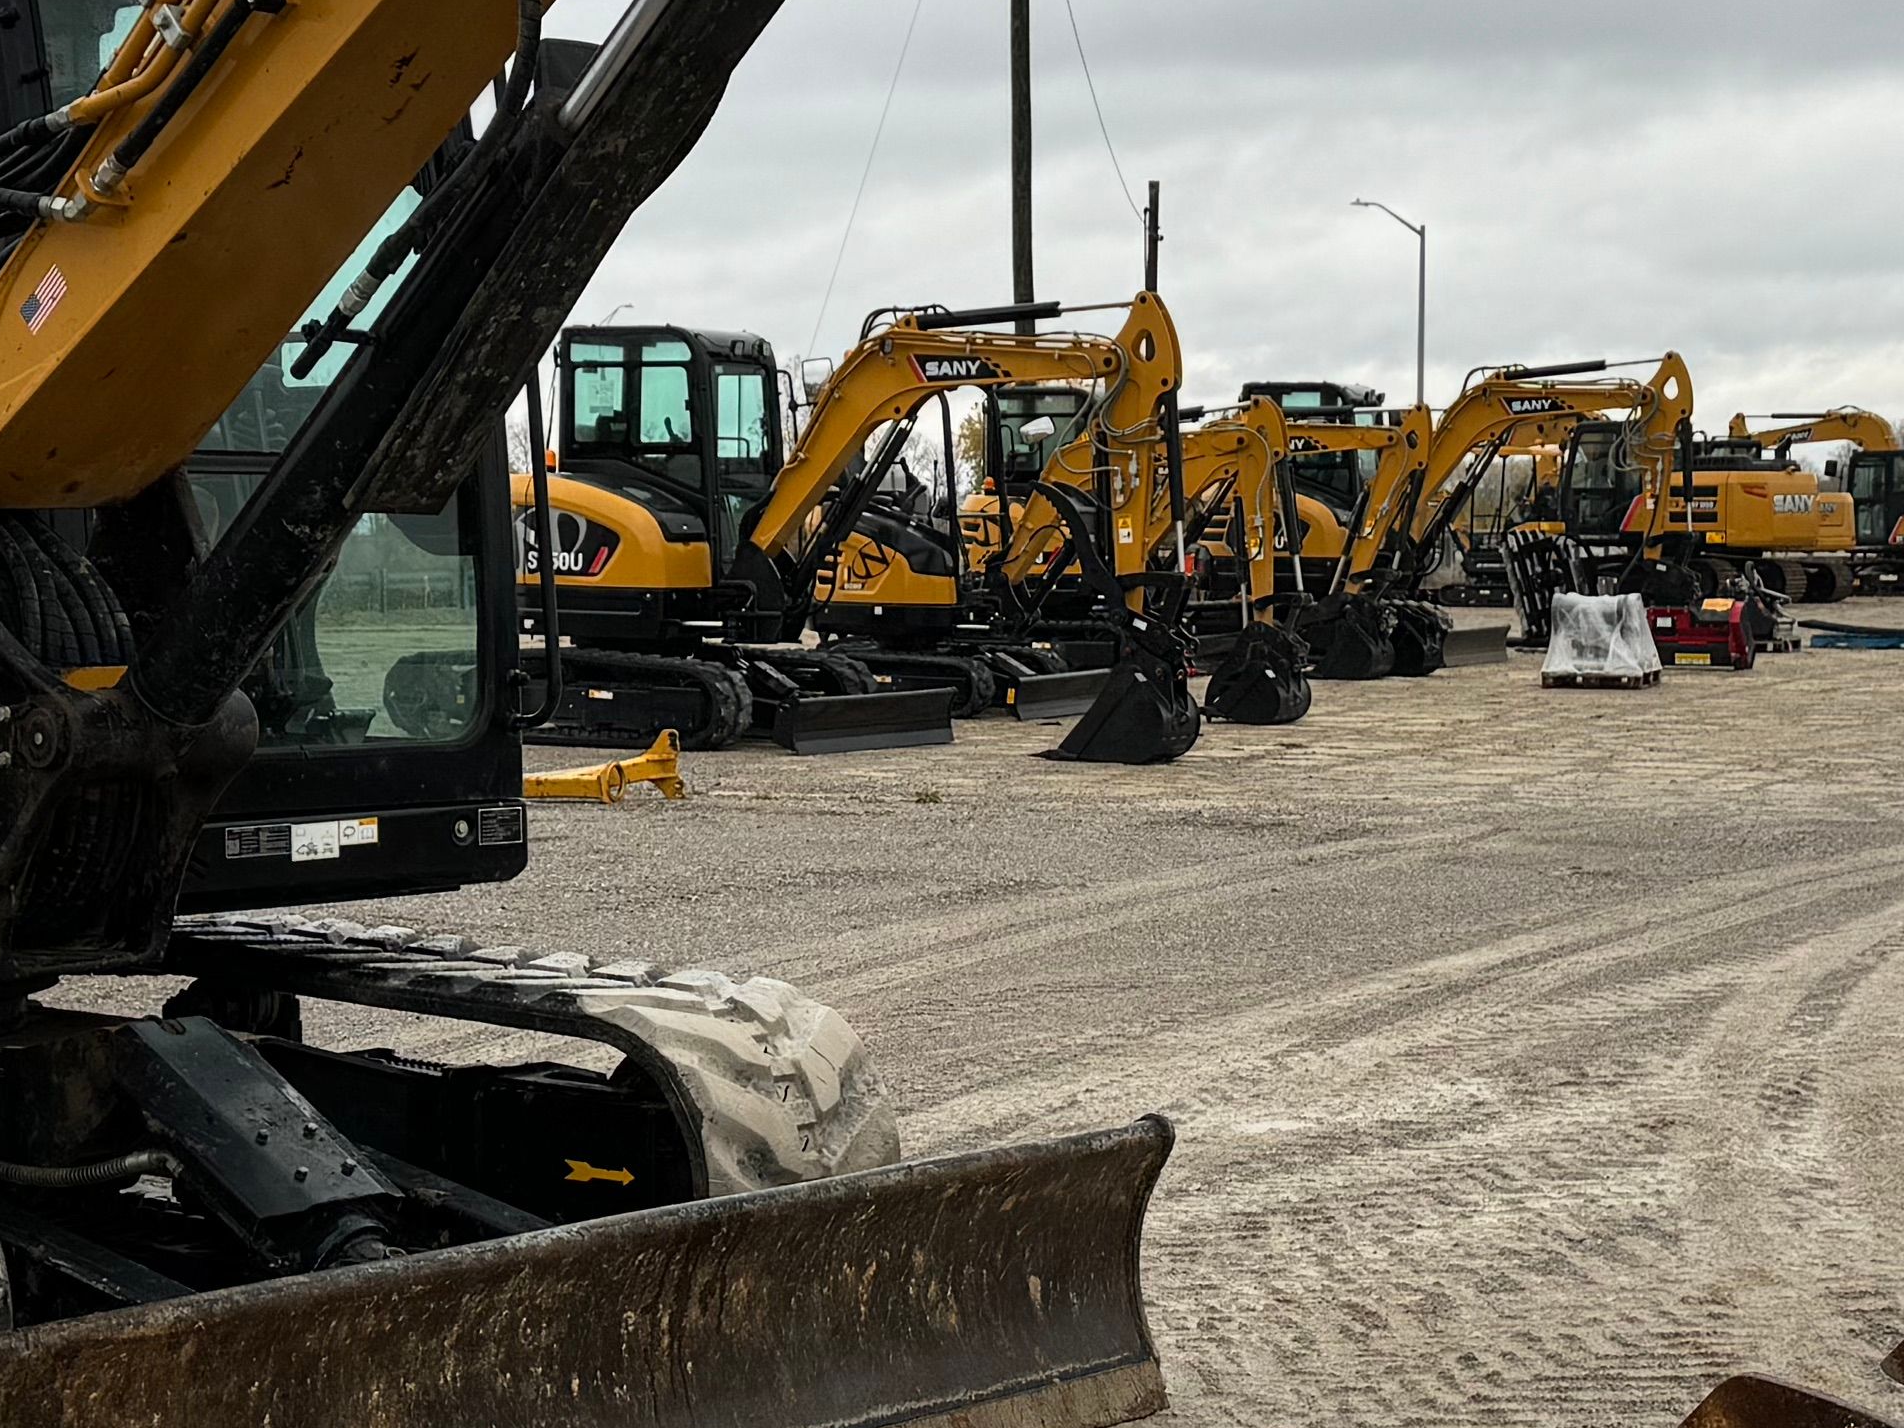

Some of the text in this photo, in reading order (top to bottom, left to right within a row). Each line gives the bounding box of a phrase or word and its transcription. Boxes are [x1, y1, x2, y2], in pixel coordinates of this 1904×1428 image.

[925, 360, 982, 377] SANY
[1511, 398, 1553, 412] SANY
[1773, 494, 1815, 513] SANY
